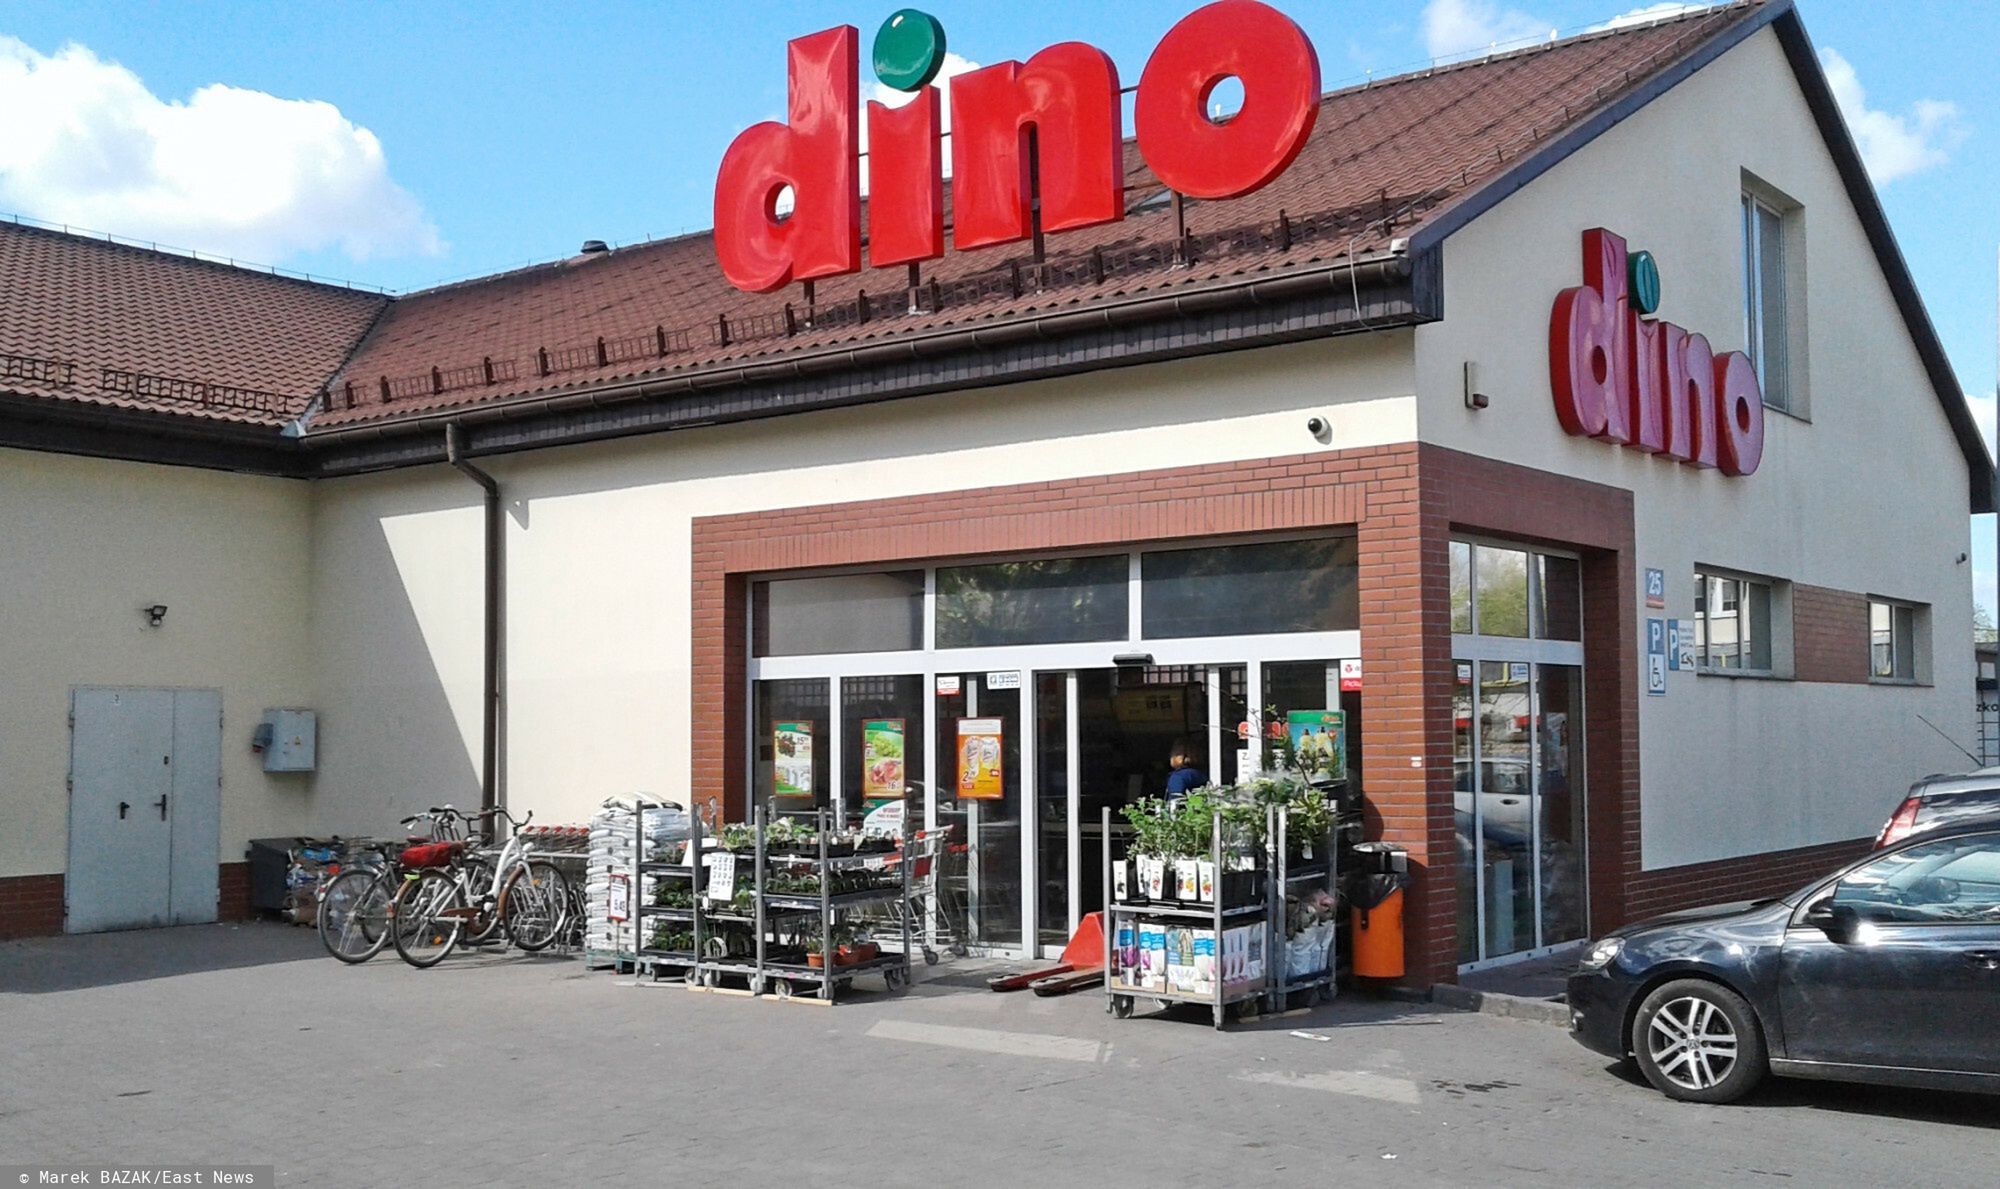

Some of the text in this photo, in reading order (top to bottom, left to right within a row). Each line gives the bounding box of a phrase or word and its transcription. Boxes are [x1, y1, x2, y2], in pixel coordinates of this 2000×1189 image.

[714, 0, 1321, 292] dino
[1549, 227, 1764, 477] dino
[1648, 571, 1662, 595] 25
[1651, 622, 1661, 651] P
[1669, 628, 1677, 660] P
